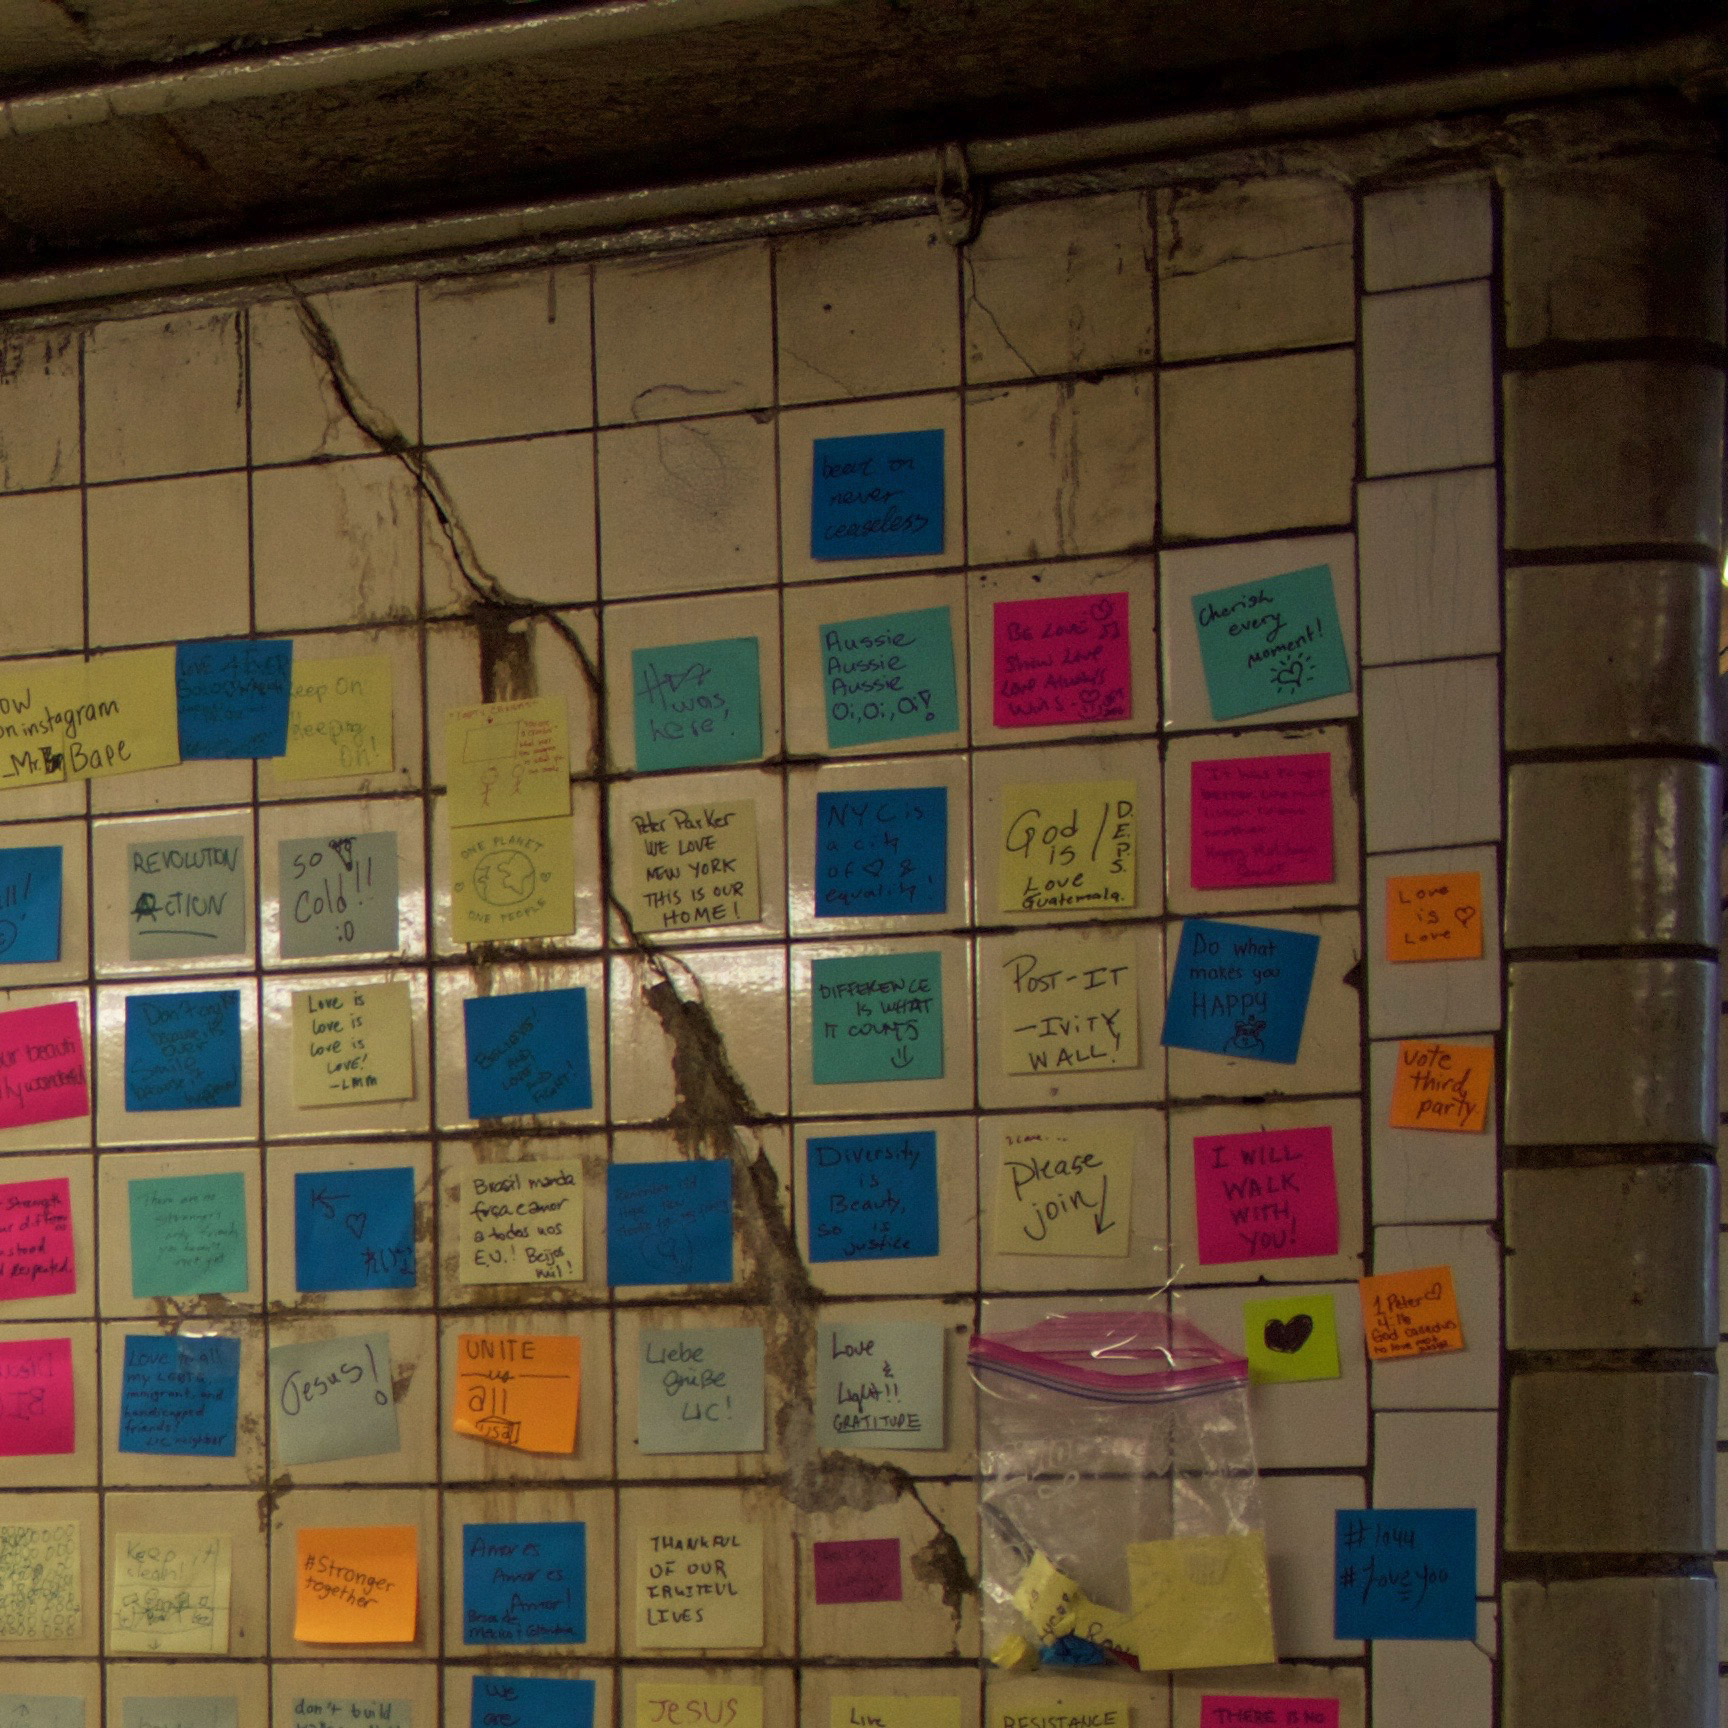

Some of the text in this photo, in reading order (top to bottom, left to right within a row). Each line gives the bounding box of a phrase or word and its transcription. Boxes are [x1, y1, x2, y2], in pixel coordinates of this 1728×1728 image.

[1228, 610, 1287, 642] every
[826, 632, 915, 652] Aussie
[828, 656, 907, 676] Aussie
[832, 677, 903, 695] Aussie
[644, 837, 716, 856] WE LOVE
[688, 859, 737, 876] YORK
[643, 882, 744, 908] THIS IS OUR
[1233, 936, 1276, 957] what
[1189, 964, 1282, 983] makes you
[1191, 991, 1269, 1018] HAPPY
[1210, 1145, 1304, 1169] I WILL
[1222, 1173, 1299, 1196] WALK
[1229, 1203, 1291, 1224] WITH
[466, 1338, 535, 1362] UNITE
[832, 1413, 923, 1433] GRATITUDE
[650, 1559, 727, 1580] OF OUR
[646, 1606, 705, 1627] LIVES
